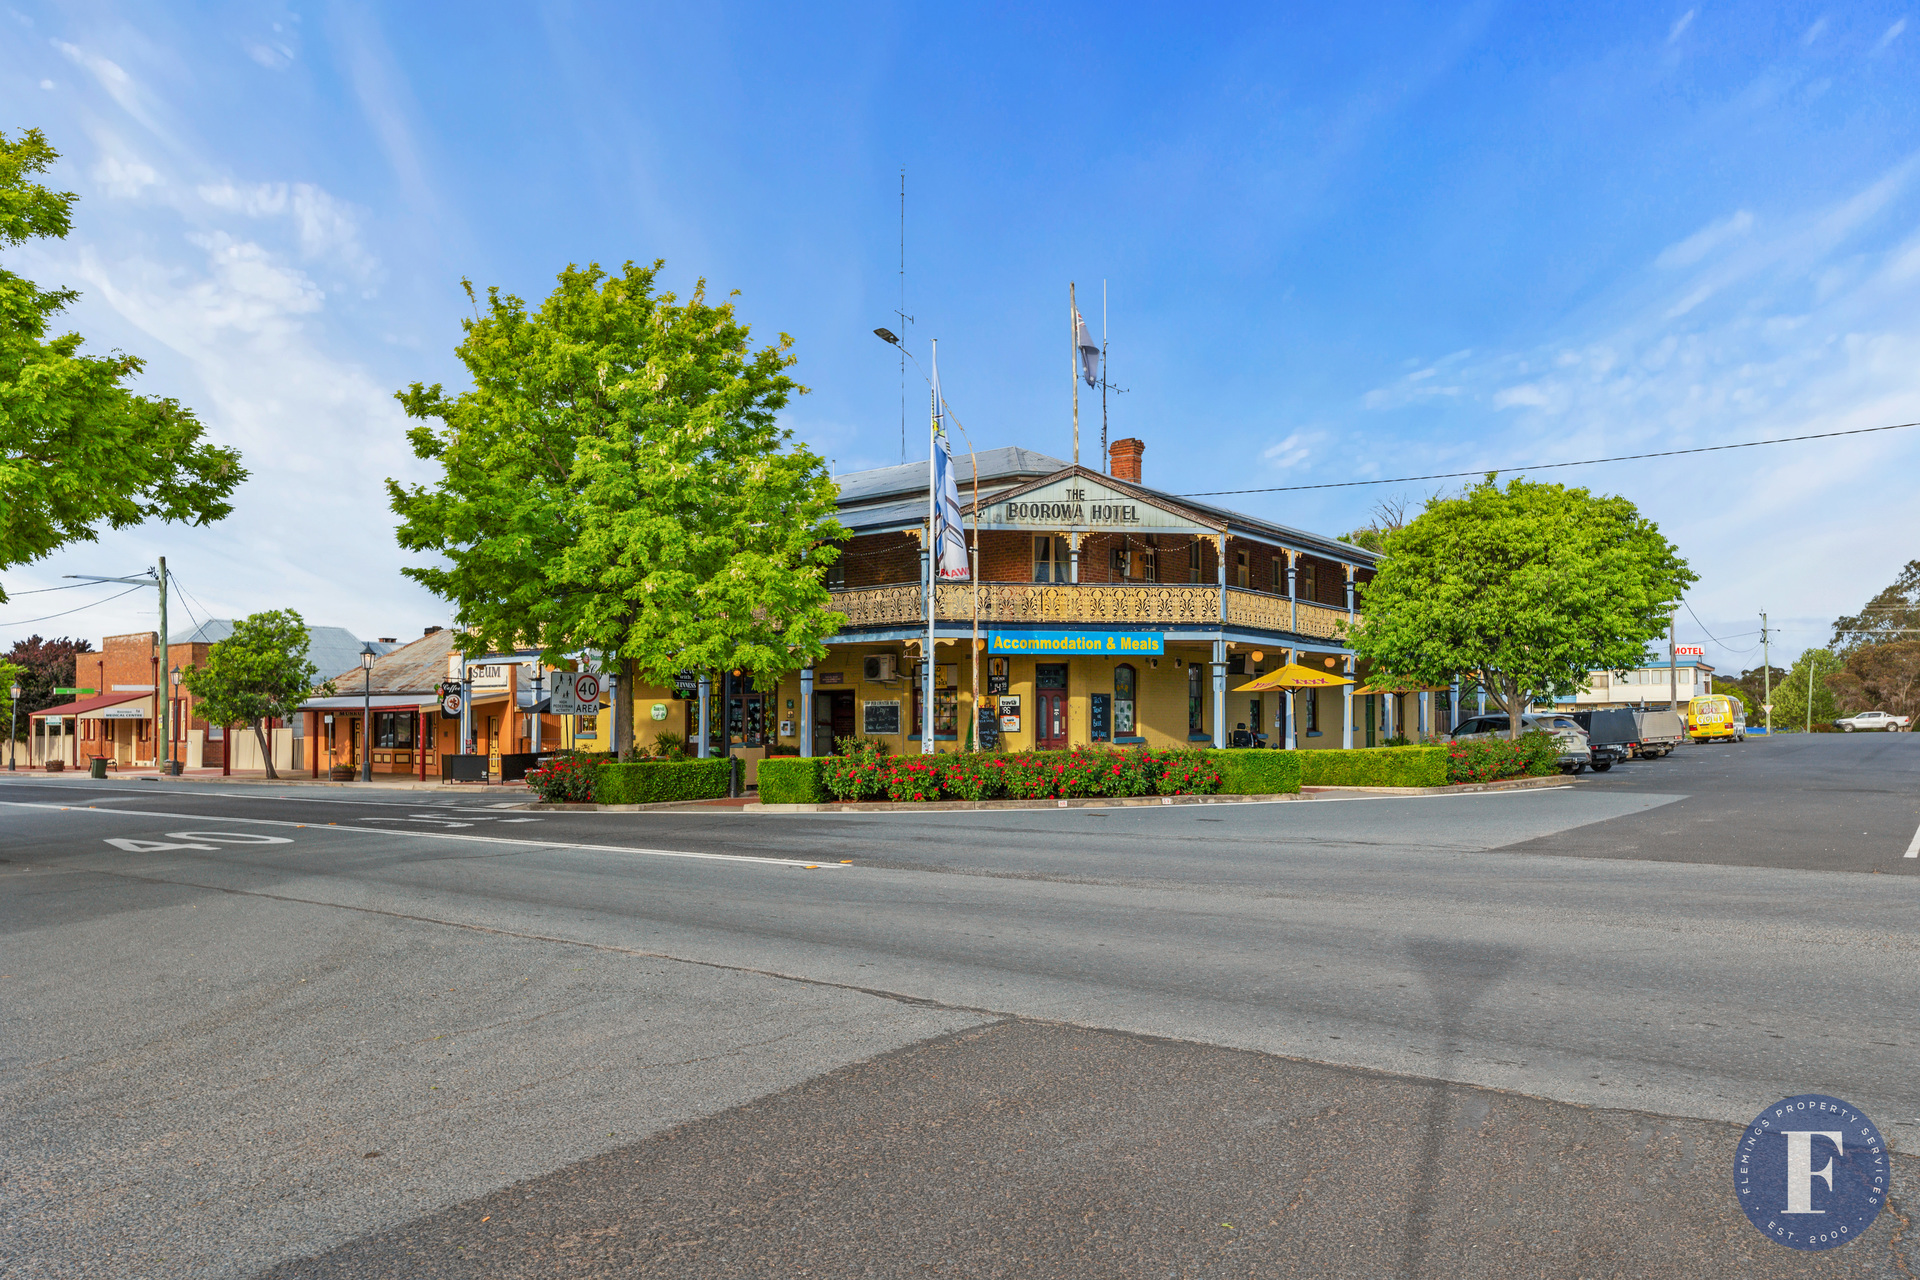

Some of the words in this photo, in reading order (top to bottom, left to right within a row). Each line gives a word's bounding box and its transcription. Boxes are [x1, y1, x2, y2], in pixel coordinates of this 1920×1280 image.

[1066, 489, 1085, 501] THE
[1007, 503, 1084, 520] BOOROWA
[1091, 505, 1140, 521] HOTEL
[994, 636, 1101, 650] Accommodation
[1106, 637, 1116, 650] &
[1121, 637, 1159, 650] Meals
[1675, 647, 1704, 655] MOTEL
[579, 682, 596, 695] 40
[576, 704, 598, 712] AREA
[1697, 714, 1724, 724] GOLD
[103, 832, 294, 852] 40
